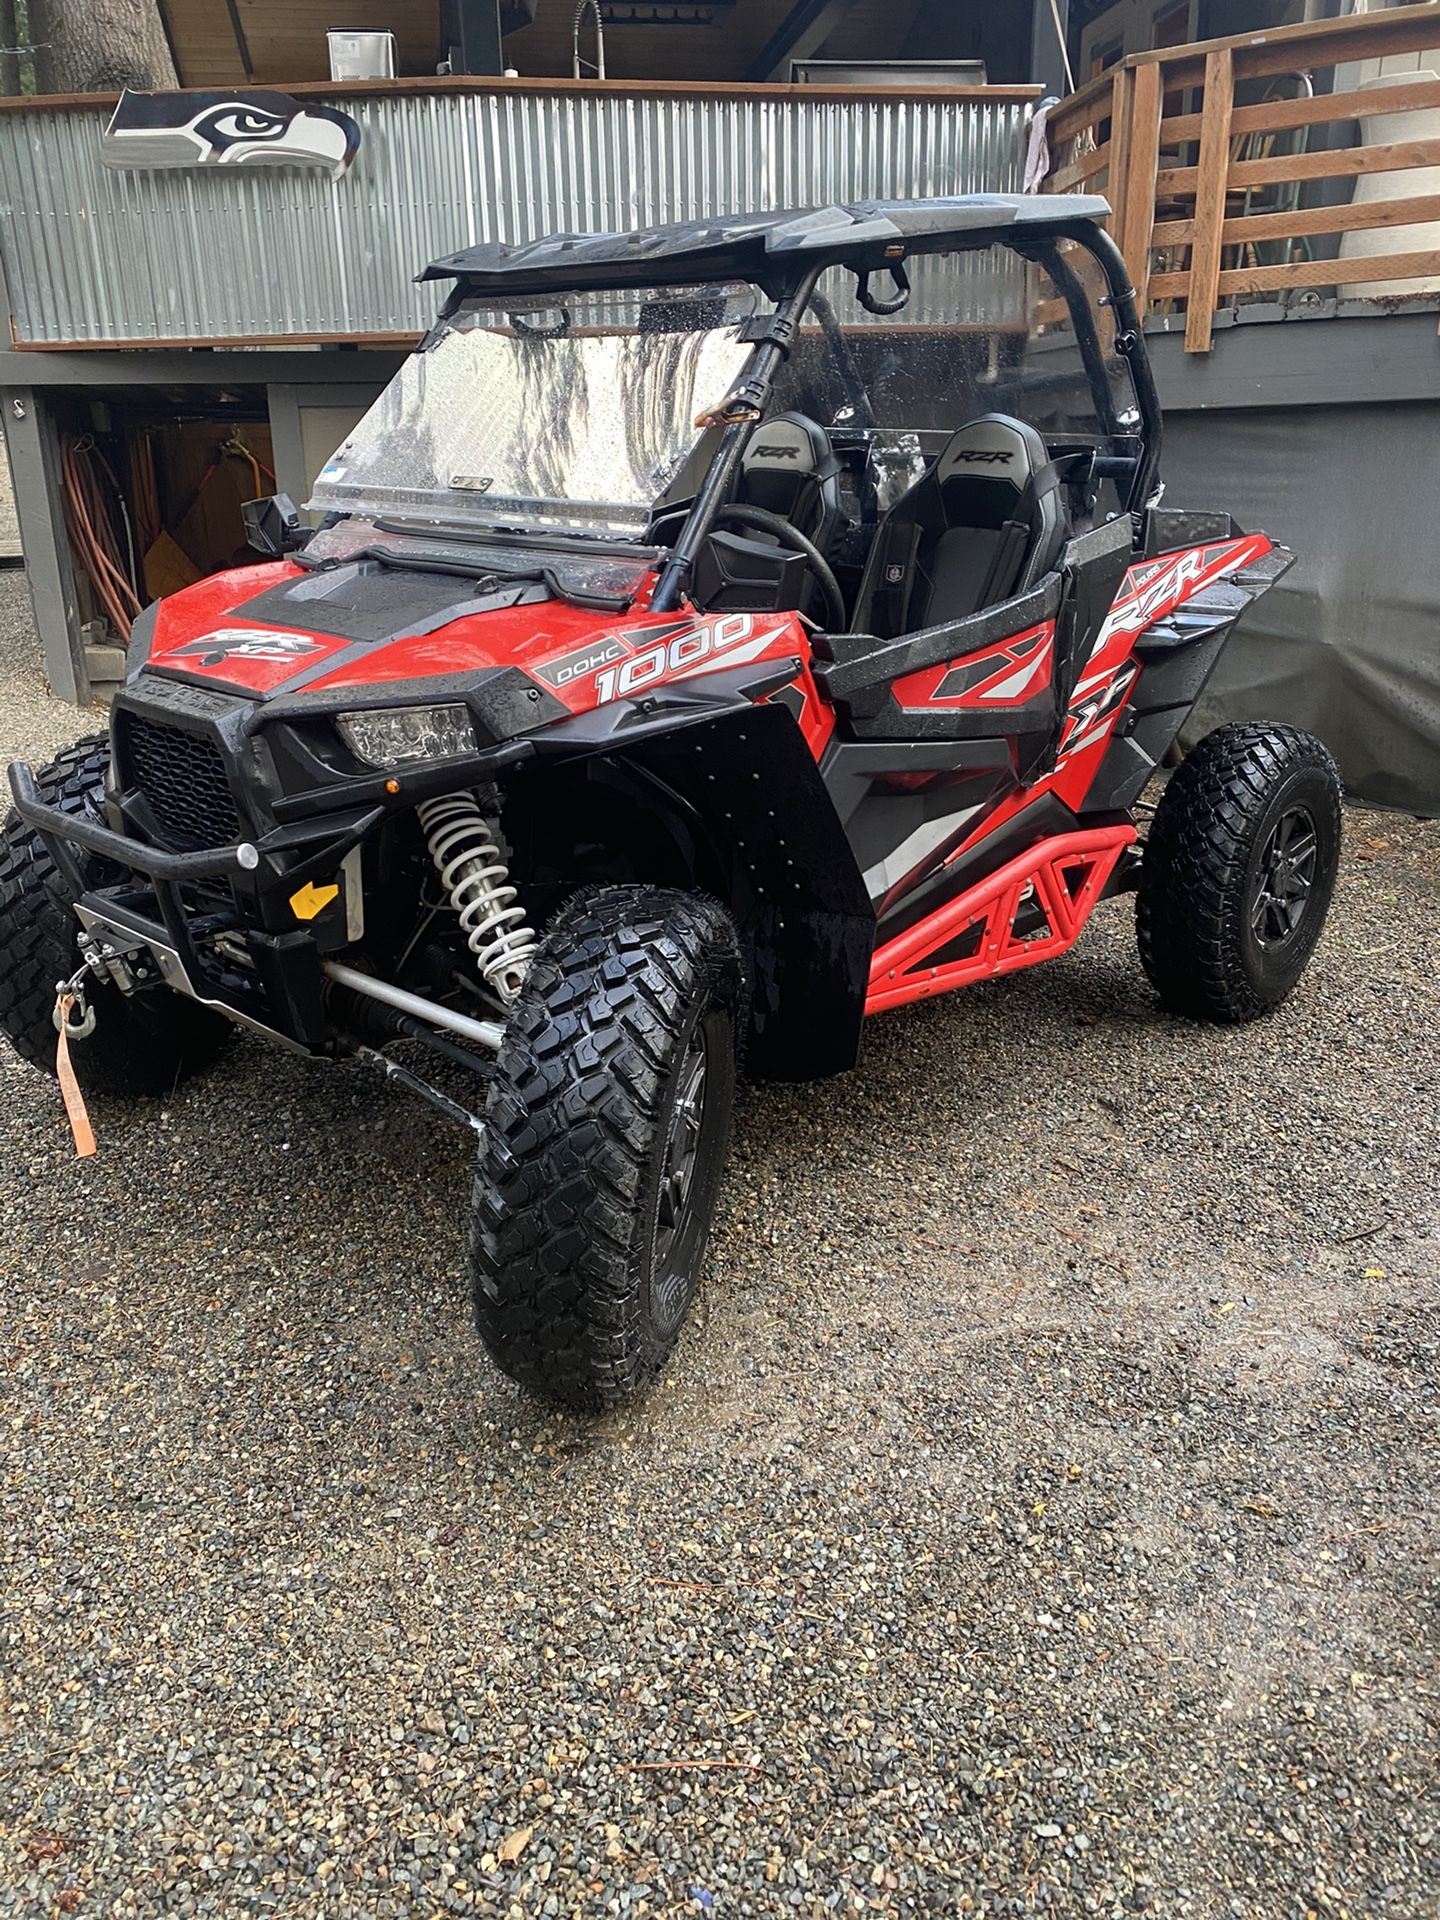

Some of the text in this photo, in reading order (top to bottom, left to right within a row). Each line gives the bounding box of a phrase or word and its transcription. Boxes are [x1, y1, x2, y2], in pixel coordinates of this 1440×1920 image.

[750, 445, 800, 460] RZR
[953, 450, 1015, 465] RZR
[1090, 549, 1206, 660] RZR
[556, 643, 621, 684] DOHC
[596, 612, 753, 705] 1000
